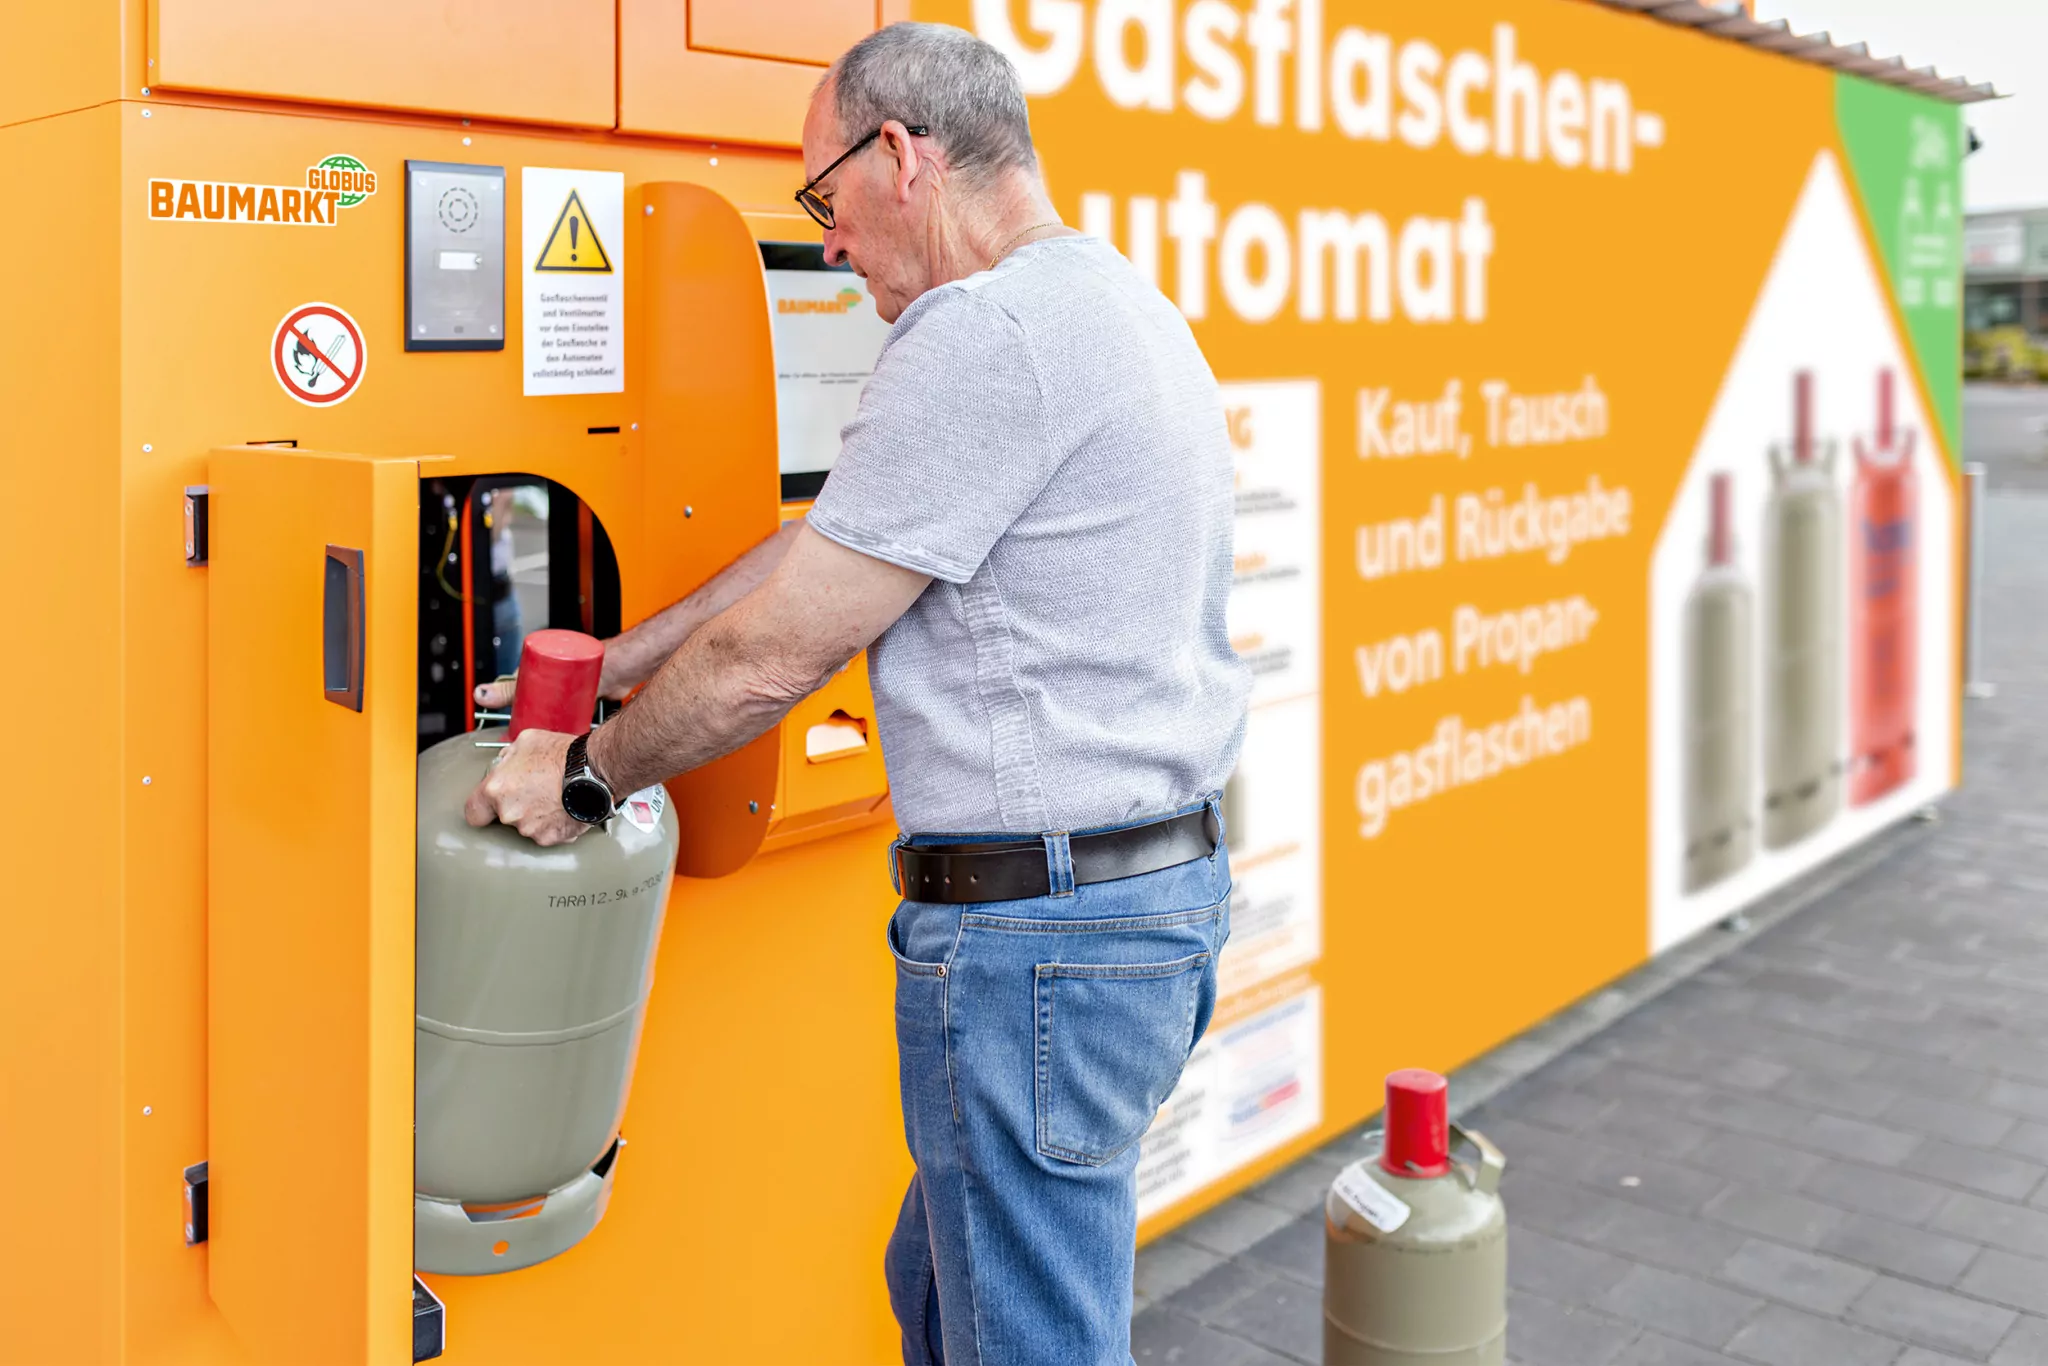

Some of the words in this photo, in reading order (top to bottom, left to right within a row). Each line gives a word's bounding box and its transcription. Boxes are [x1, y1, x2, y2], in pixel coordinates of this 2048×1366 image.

[150, 180, 340, 225] BAUMARKT
[308, 168, 376, 193] GLOBUS
[1081, 167, 1492, 323] utomat
[1357, 378, 1472, 460] Kauf,
[1479, 374, 1610, 447] Tausch
[1356, 493, 1446, 580] und
[1454, 473, 1633, 565] Rückgabe
[1354, 628, 1444, 699] von
[1453, 594, 1600, 675] Propan-
[1355, 694, 1592, 839] gasflaschen
[548, 894, 587, 908] TARA
